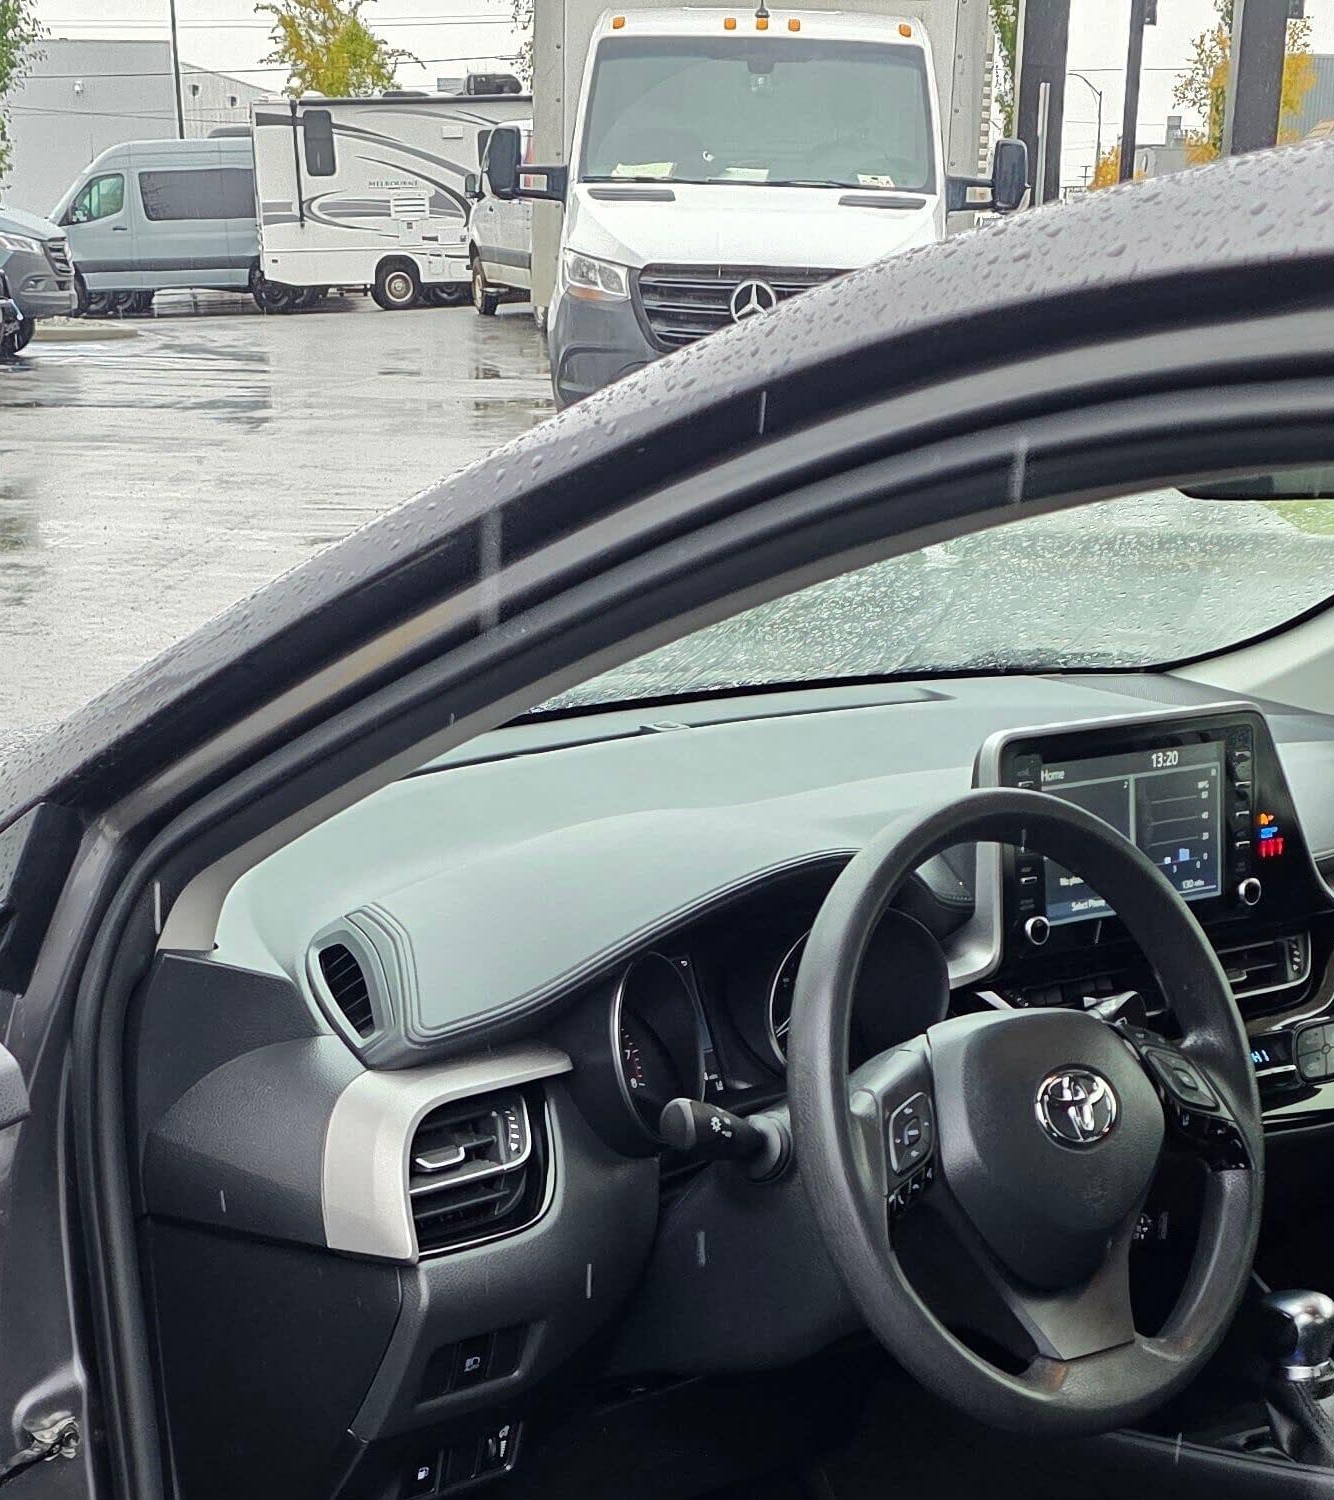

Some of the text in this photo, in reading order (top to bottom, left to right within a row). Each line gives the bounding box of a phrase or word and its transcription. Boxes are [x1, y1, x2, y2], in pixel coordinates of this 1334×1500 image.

[368, 179, 418, 187] MELBOURNE
[1151, 751, 1179, 768] 13:20
[1041, 769, 1065, 783] Home
[1251, 1049, 1270, 1063] HI
